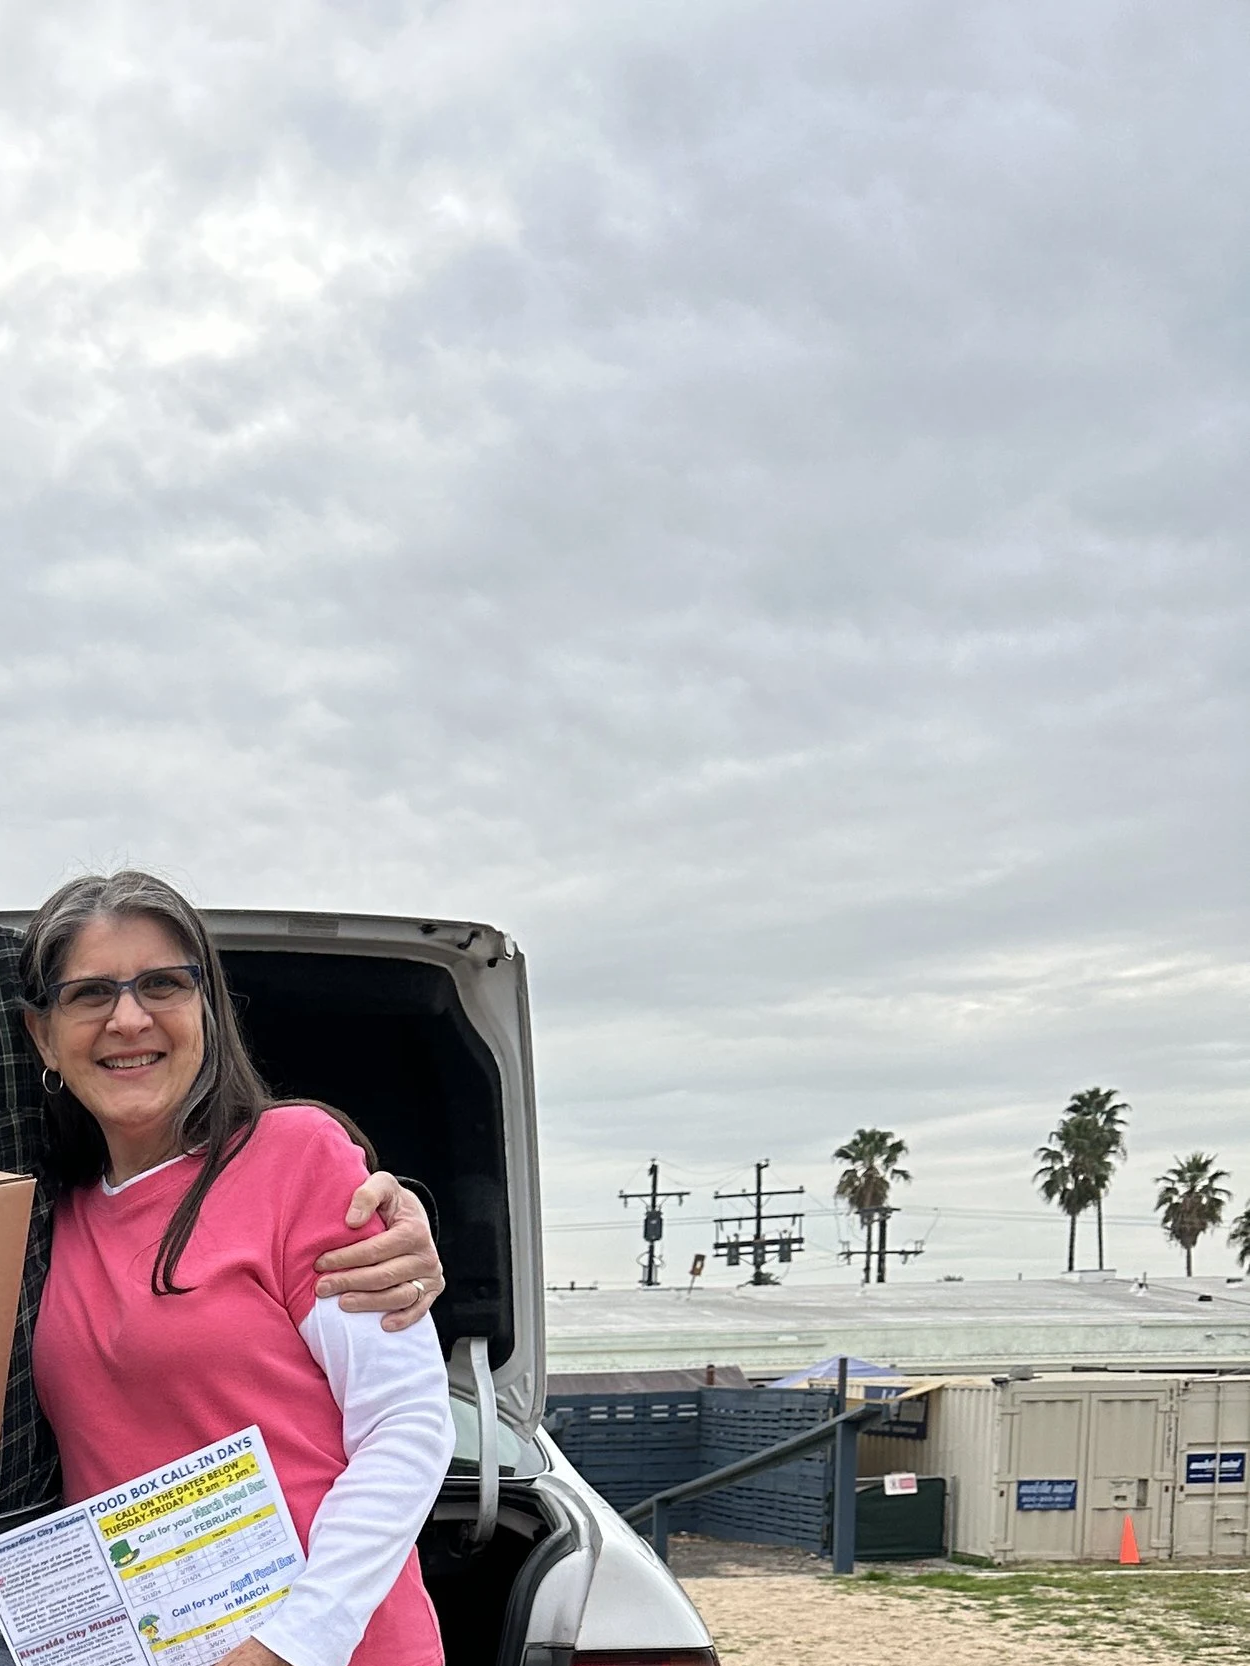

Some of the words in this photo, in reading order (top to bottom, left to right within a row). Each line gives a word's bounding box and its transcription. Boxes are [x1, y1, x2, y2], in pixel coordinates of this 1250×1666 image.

[89, 1493, 127, 1516] FOOD
[129, 1478, 159, 1499] BOX
[161, 1453, 214, 1485] CALL-IN
[216, 1436, 252, 1460] DAYS
[103, 1496, 183, 1536] TUESDAY-FRIDAY
[196, 1487, 204, 1496] 8
[204, 1481, 220, 1492] am
[226, 1474, 234, 1482] 2
[234, 1468, 250, 1480] pm
[115, 1506, 139, 1521] CALL
[139, 1499, 155, 1511] ON
[155, 1489, 175, 1503] THE
[175, 1476, 206, 1495] DATES
[206, 1460, 238, 1481] BELOW
[36, 1527, 53, 1537] City
[54, 1514, 85, 1530] Mission
[138, 1529, 157, 1543] Call
[157, 1524, 171, 1535] for
[172, 1514, 192, 1531] your
[191, 1498, 223, 1519] March
[222, 1485, 248, 1506] Food
[246, 1478, 267, 1495] Box
[183, 1529, 193, 1538] in
[193, 1505, 242, 1533] FEBRUARY
[171, 1604, 191, 1617] Call
[192, 1599, 205, 1609] for
[207, 1588, 228, 1605] your
[230, 1573, 253, 1593] April
[252, 1560, 278, 1581] Food
[276, 1553, 297, 1570] Box
[224, 1602, 234, 1611] in
[234, 1583, 269, 1605] MARCH
[19, 1637, 65, 1659] Riverside
[66, 1628, 86, 1641] City
[88, 1613, 127, 1632] Mission
